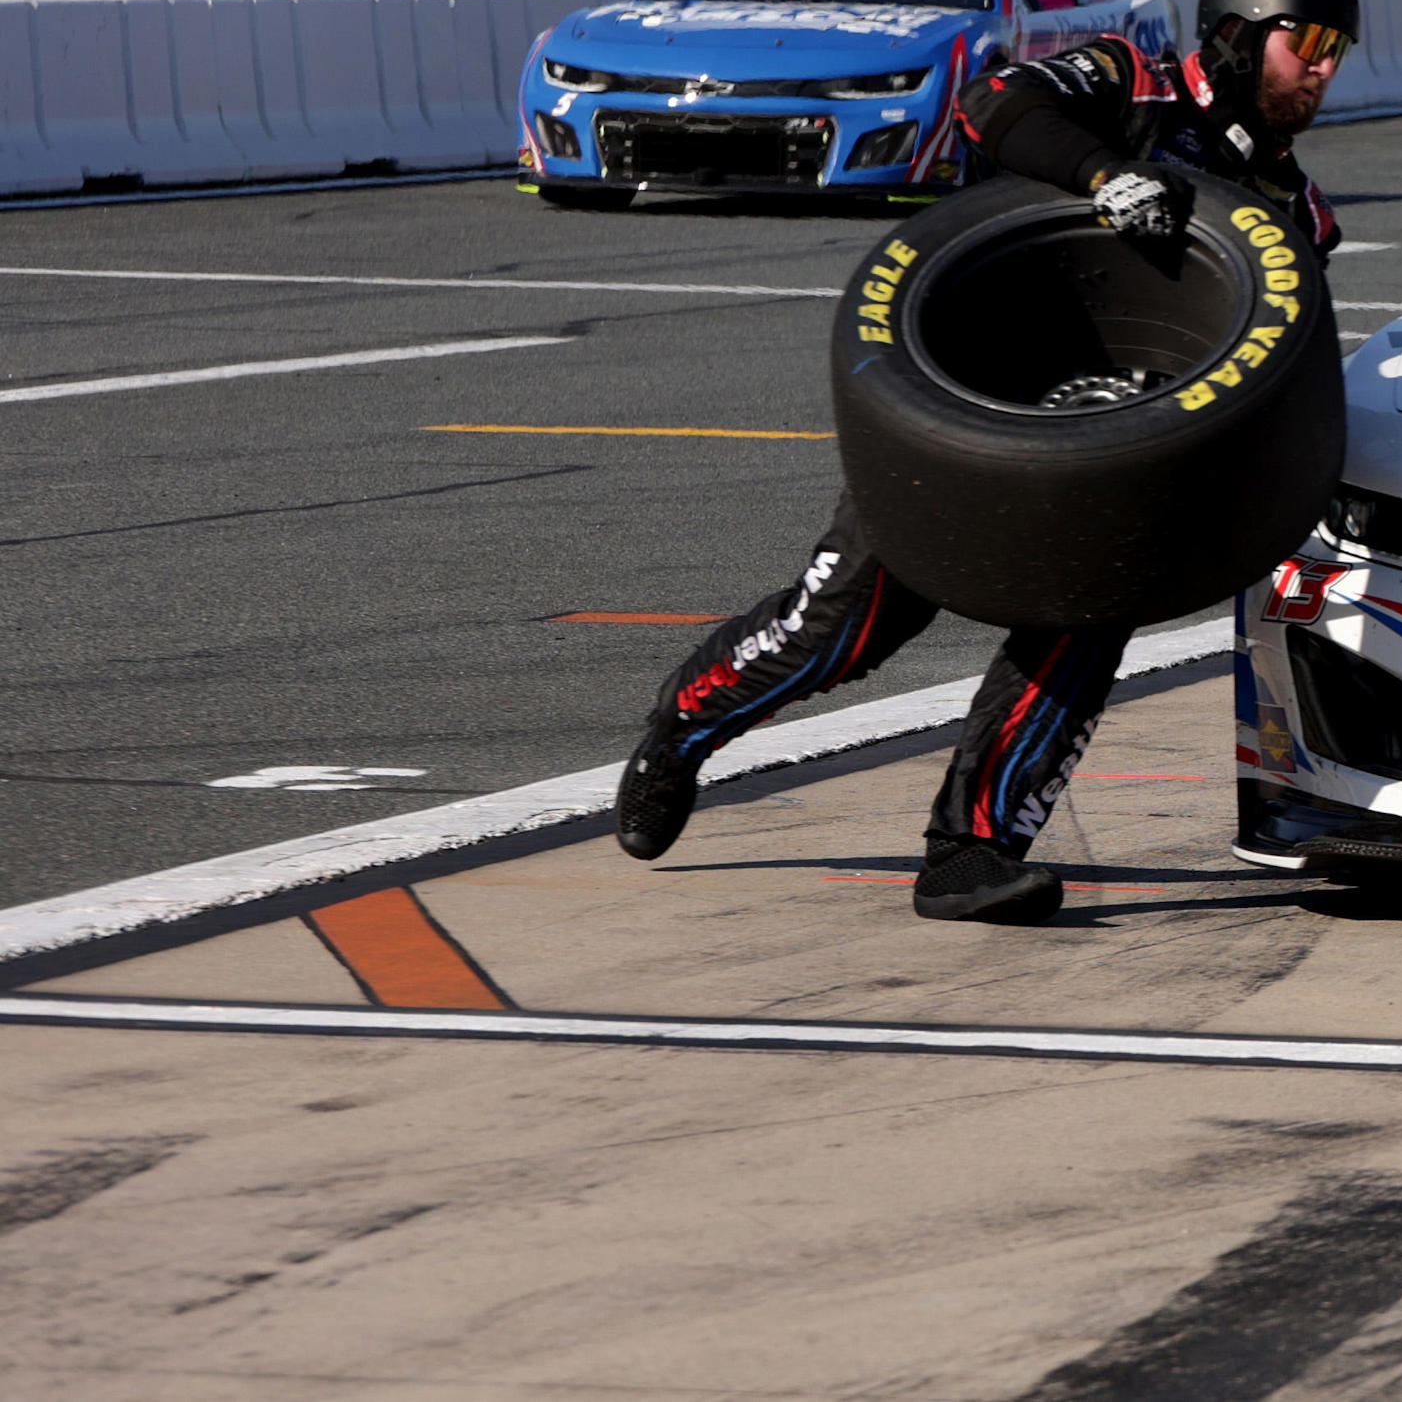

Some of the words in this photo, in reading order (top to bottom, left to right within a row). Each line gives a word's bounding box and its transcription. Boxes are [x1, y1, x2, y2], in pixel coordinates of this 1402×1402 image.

[551, 92, 578, 116] 5
[858, 239, 919, 345] EAGLE
[1261, 554, 1352, 626] 13
